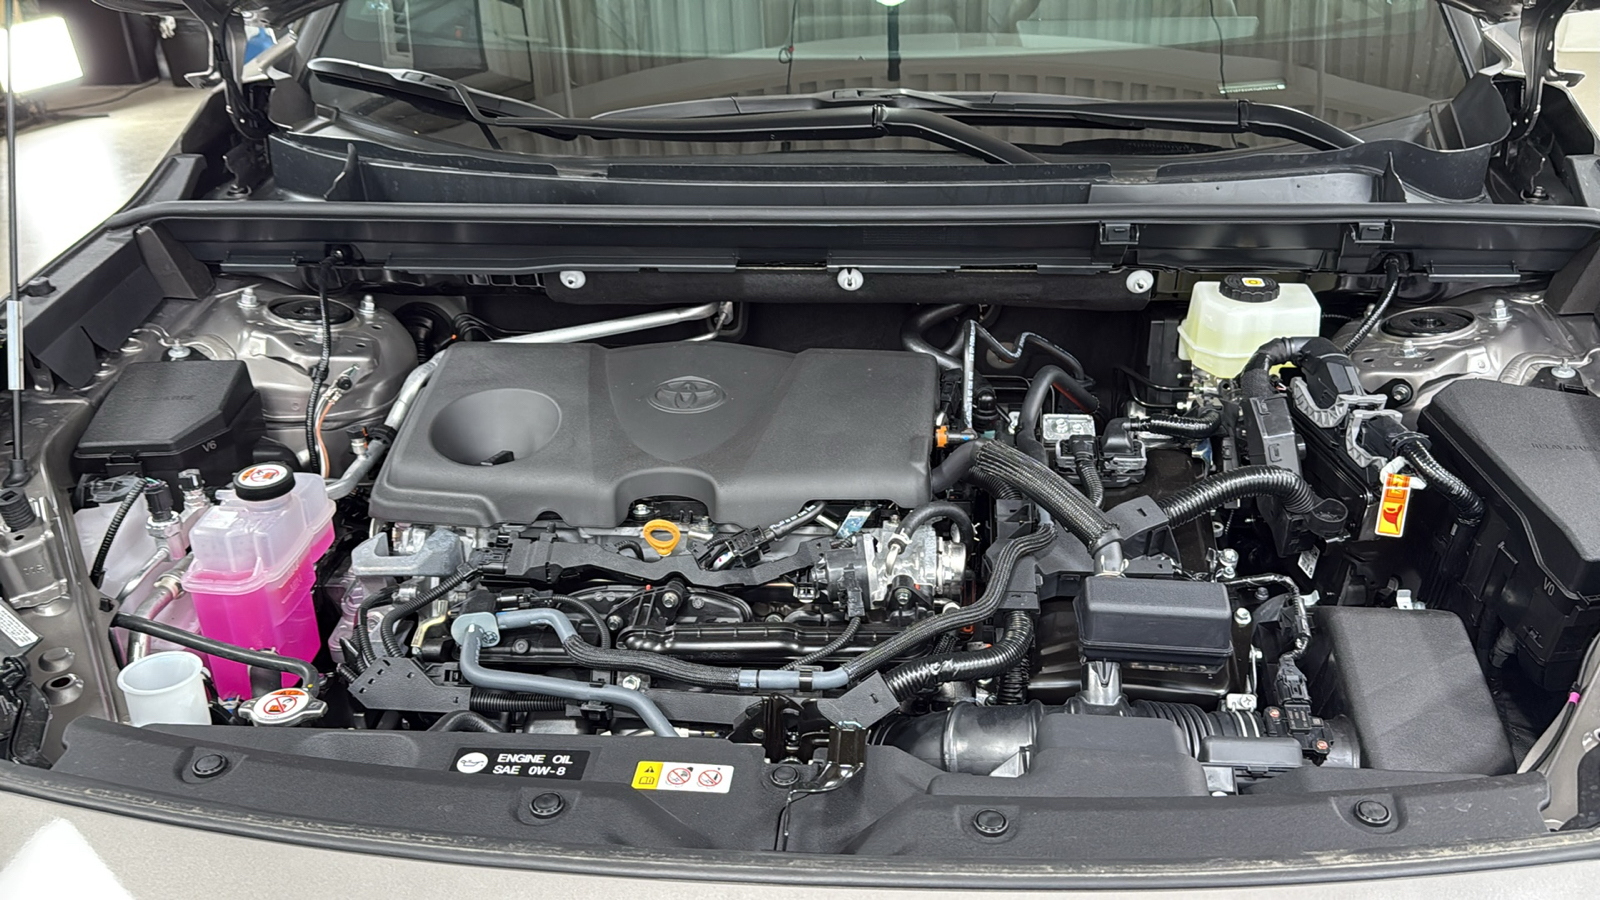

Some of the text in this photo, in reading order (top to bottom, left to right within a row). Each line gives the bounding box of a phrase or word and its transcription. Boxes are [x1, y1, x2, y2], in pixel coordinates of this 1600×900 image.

[497, 753, 573, 764] ENGINE OIL
[492, 764, 566, 776] SAE 0W-8
